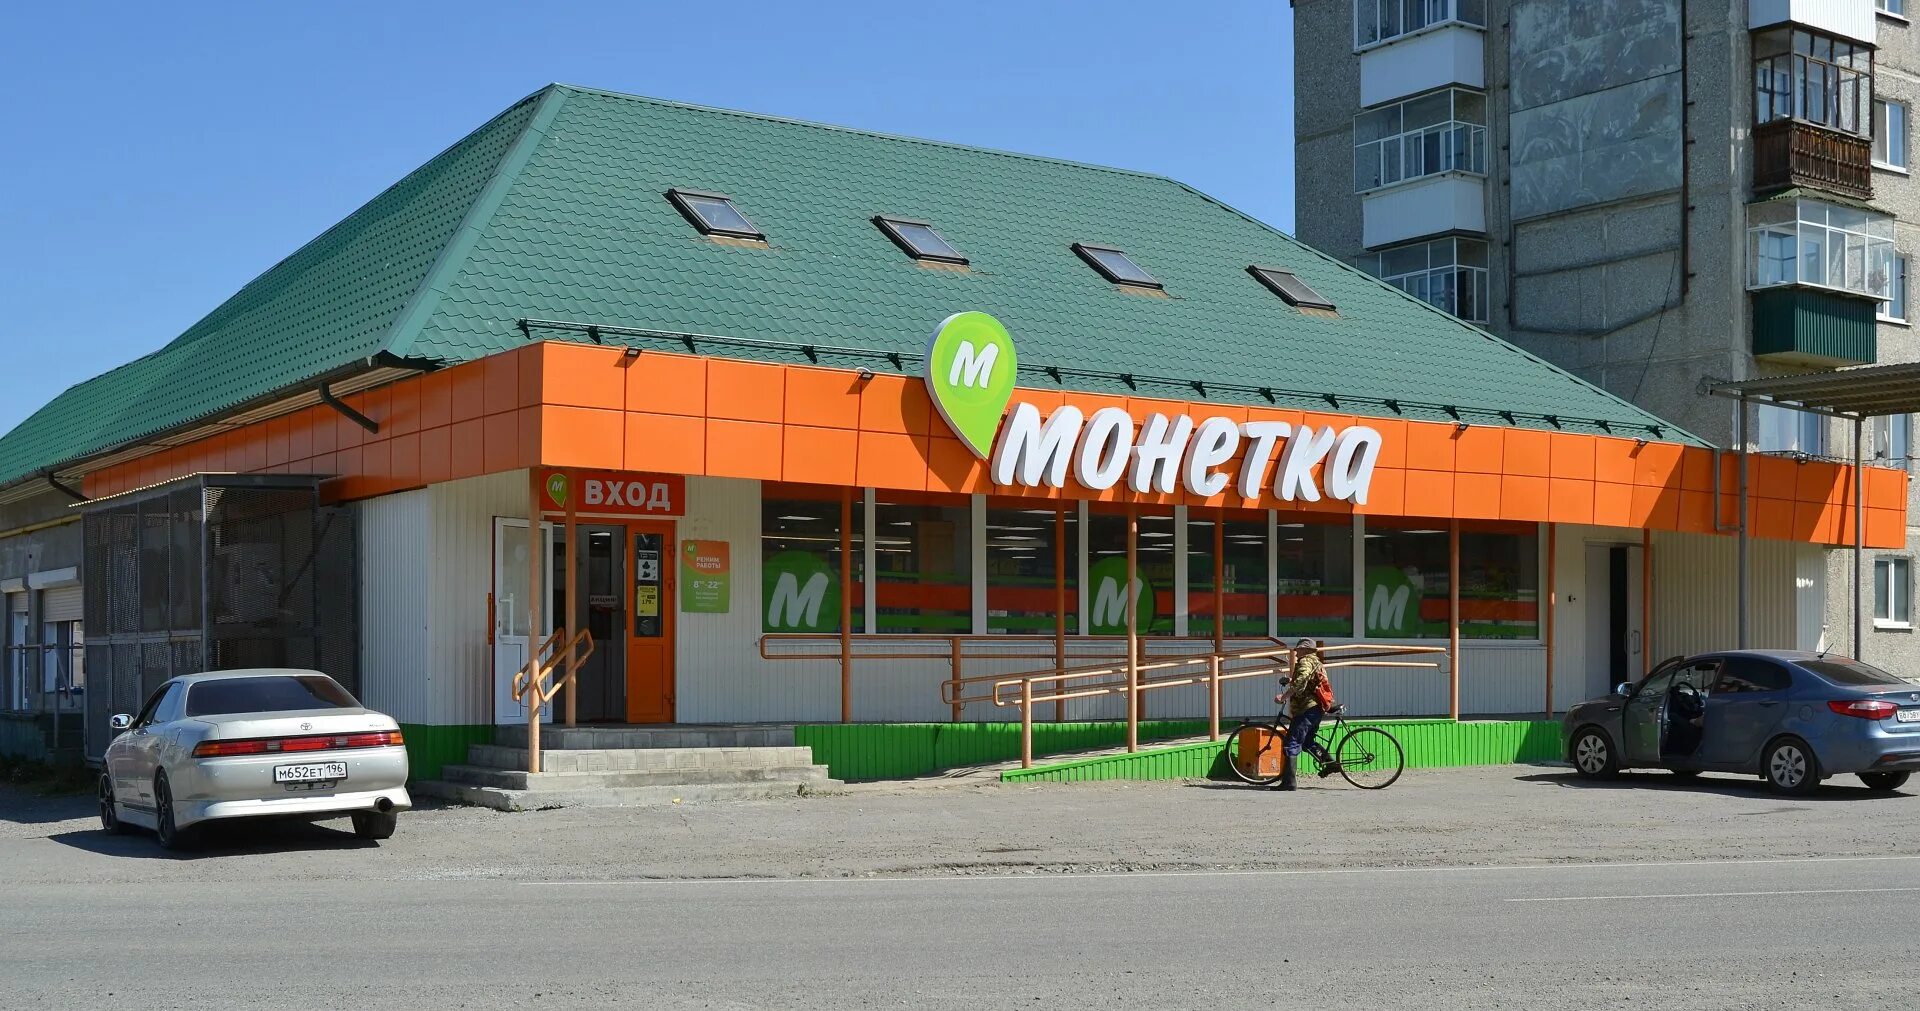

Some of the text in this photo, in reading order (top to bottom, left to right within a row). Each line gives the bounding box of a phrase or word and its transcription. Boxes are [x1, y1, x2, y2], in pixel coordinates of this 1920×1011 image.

[949, 340, 999, 389] М
[585, 479, 671, 512] ВХОД
[768, 571, 829, 628] М
[1368, 584, 1410, 630] М
[279, 764, 343, 779] М652ЕТ 196
